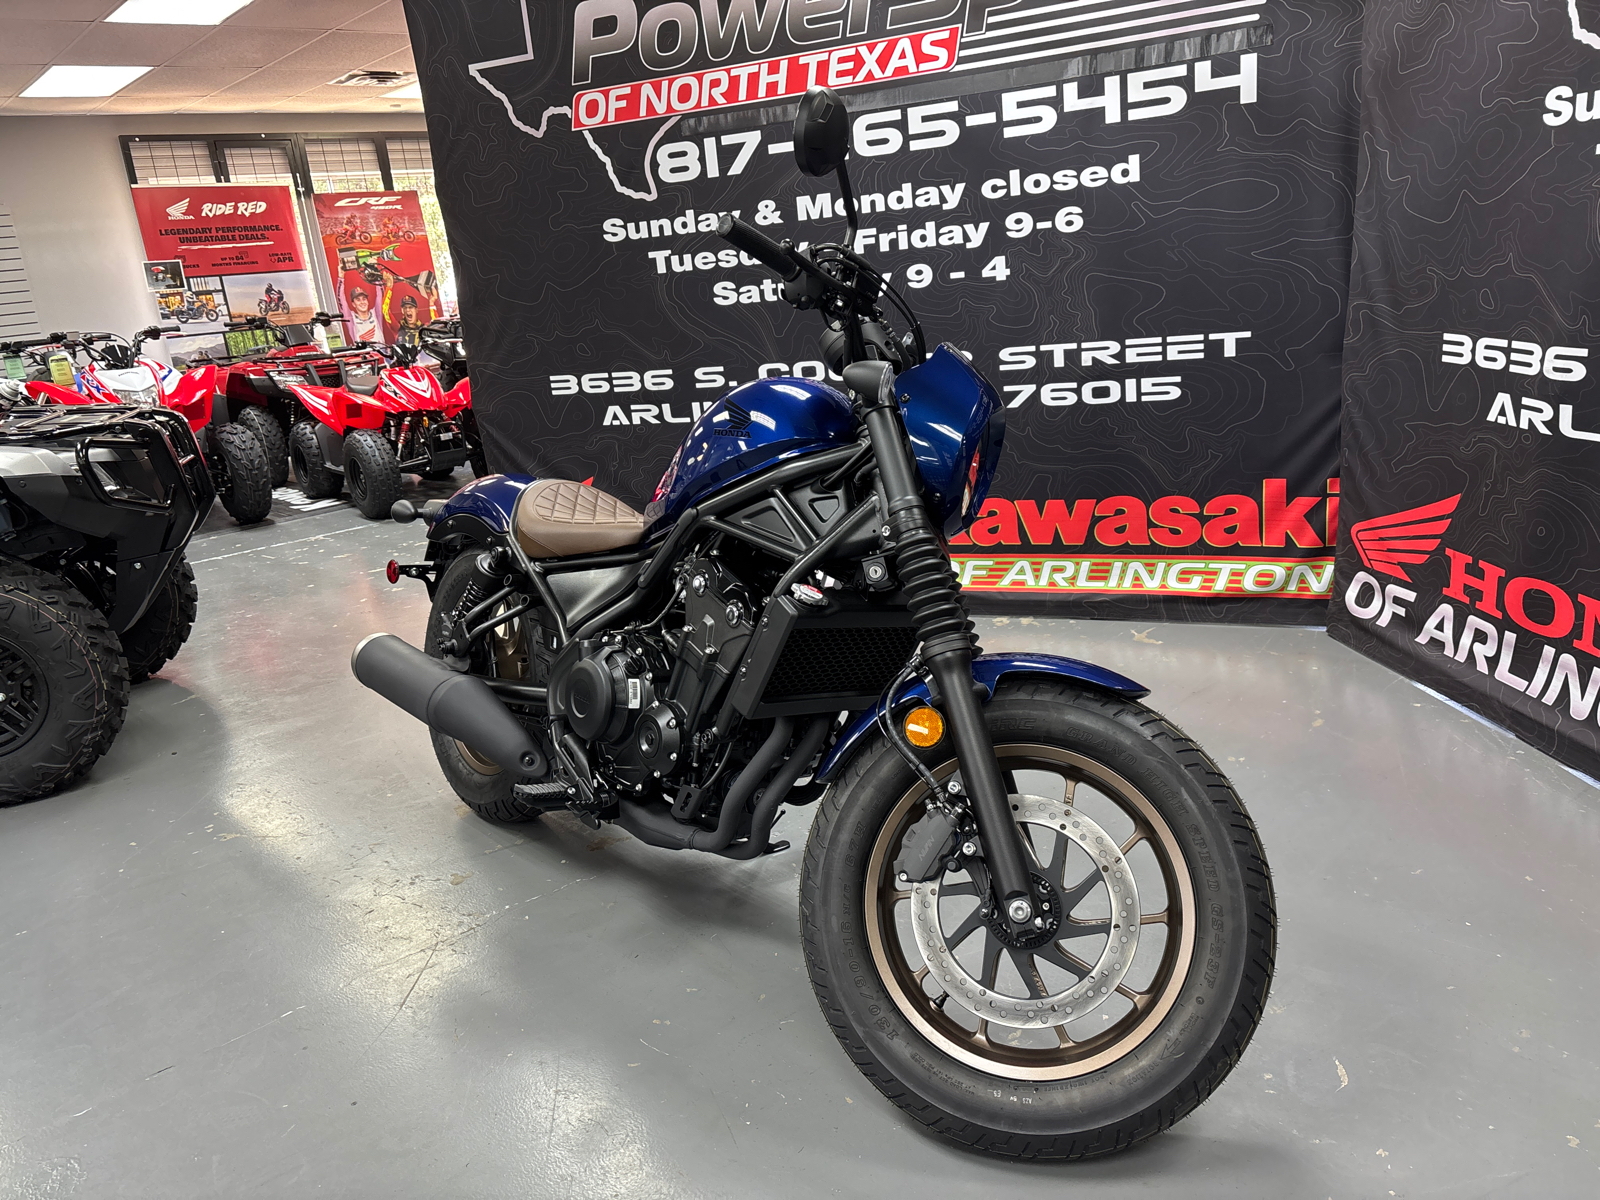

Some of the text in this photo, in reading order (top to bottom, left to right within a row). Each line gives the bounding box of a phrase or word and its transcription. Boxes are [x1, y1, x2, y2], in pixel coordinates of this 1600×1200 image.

[578, 30, 951, 126] OF NORTH TEXAS
[656, 53, 1258, 183] 817-65-5454
[201, 202, 235, 218] RIDE
[237, 201, 267, 217] RED
[334, 196, 402, 207] CRF
[754, 199, 784, 226] &
[796, 182, 966, 222] Monday
[981, 153, 1141, 200] closed
[159, 224, 284, 236] LEGENDARY PERFORMANCE.
[178, 232, 270, 244] UNBEATABLE DEALS.
[853, 220, 990, 256] Friday
[1004, 206, 1084, 239] 9-6
[906, 263, 934, 289] 9
[950, 271, 966, 280] -
[980, 255, 1011, 281] 4
[550, 368, 674, 396] 3636
[694, 365, 738, 389] S.
[998, 331, 1252, 371] STREET
[1442, 332, 1589, 382] 3636
[1003, 376, 1182, 409] 76015
[712, 428, 752, 439] HONDA
[948, 477, 1340, 549] awasaki
[1000, 559, 1335, 593] ARLINGTON
[1345, 570, 1417, 628] OF
[1066, 726, 1137, 766] GRAND
[1143, 767, 1189, 817] HIGH
[1187, 823, 1221, 892] SPEED
